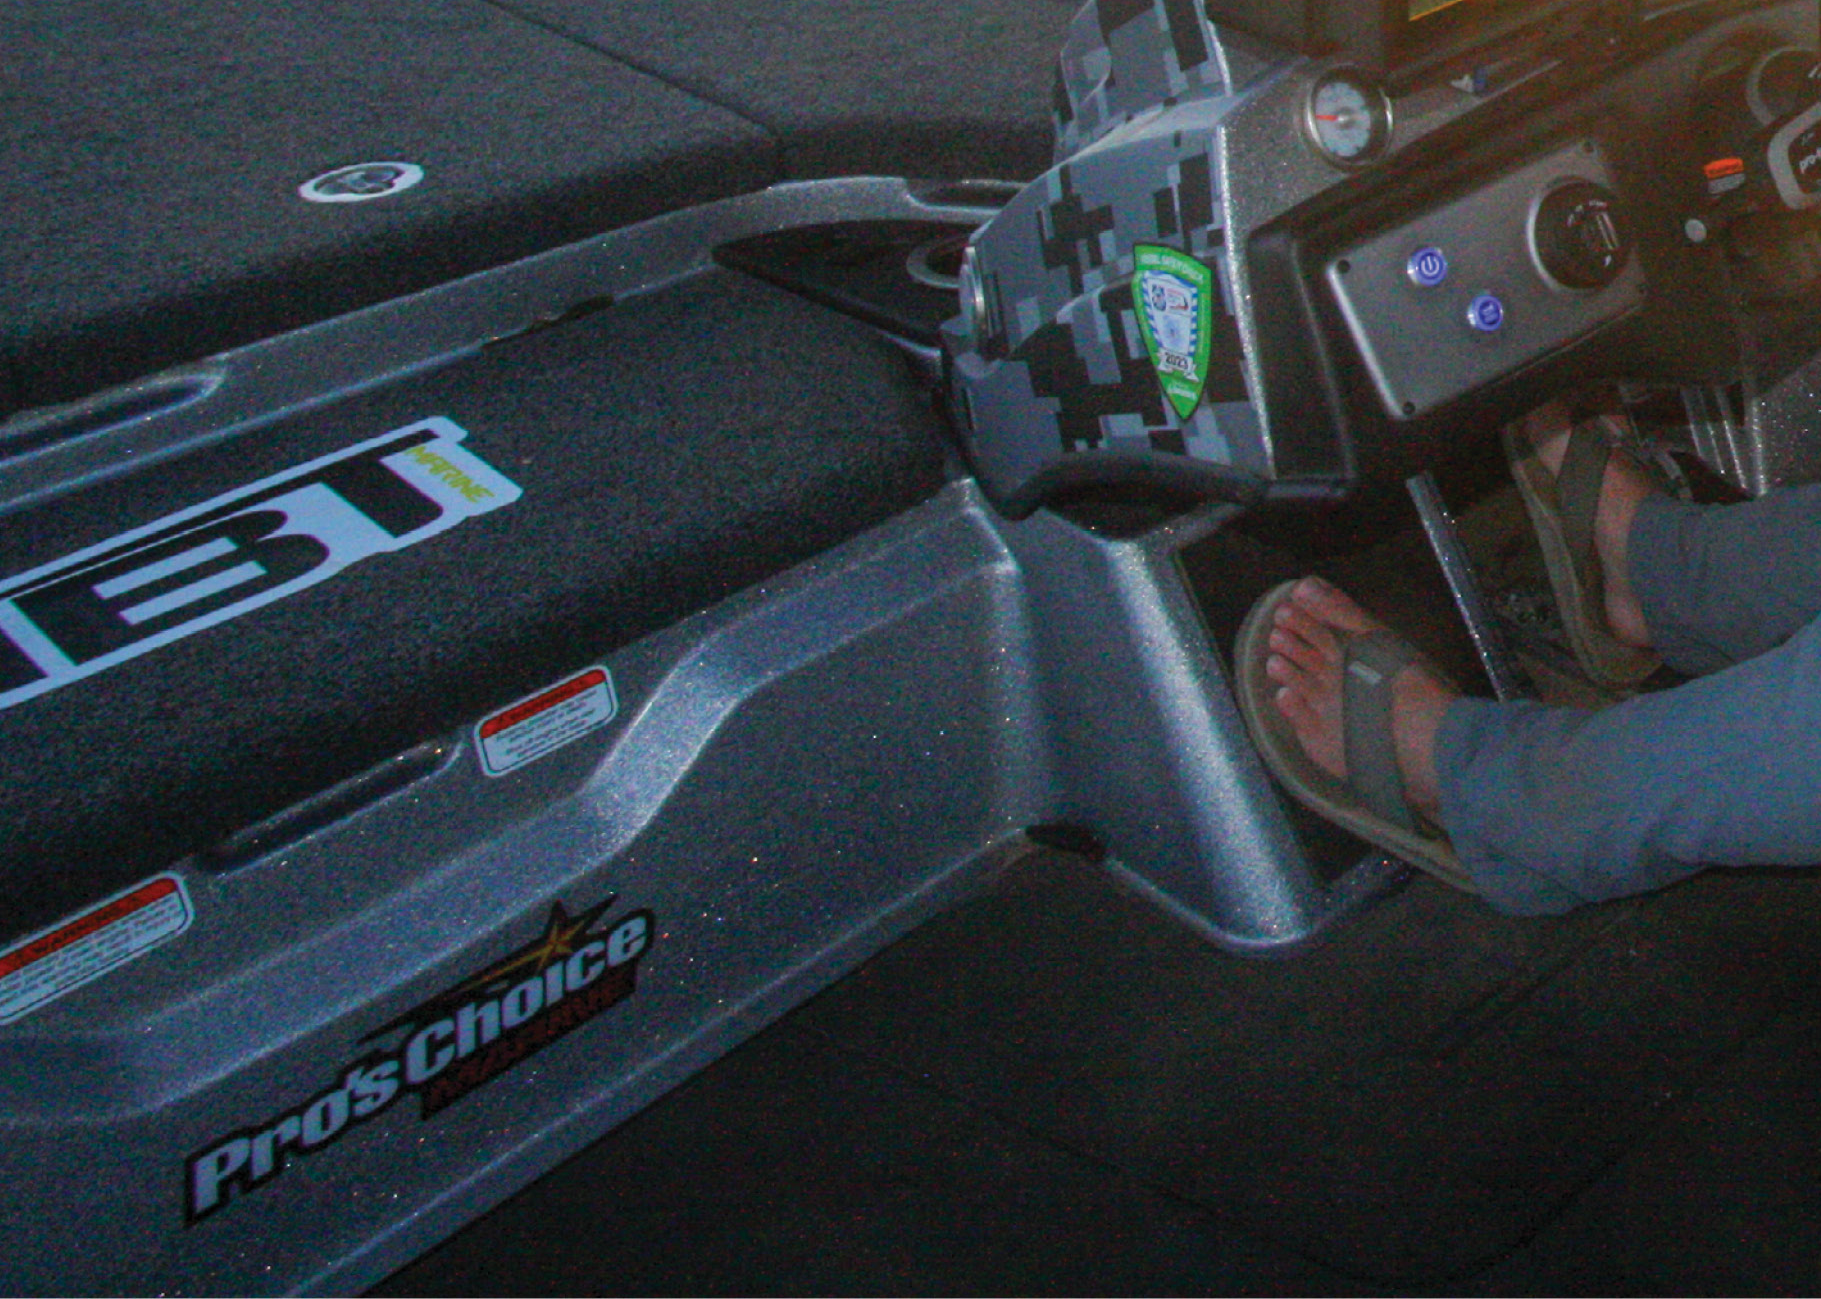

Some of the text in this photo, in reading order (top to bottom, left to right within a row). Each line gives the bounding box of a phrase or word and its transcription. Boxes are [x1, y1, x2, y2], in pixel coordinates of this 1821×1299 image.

[405, 445, 495, 504] MARINE
[193, 913, 650, 1215] Pro's Choice
